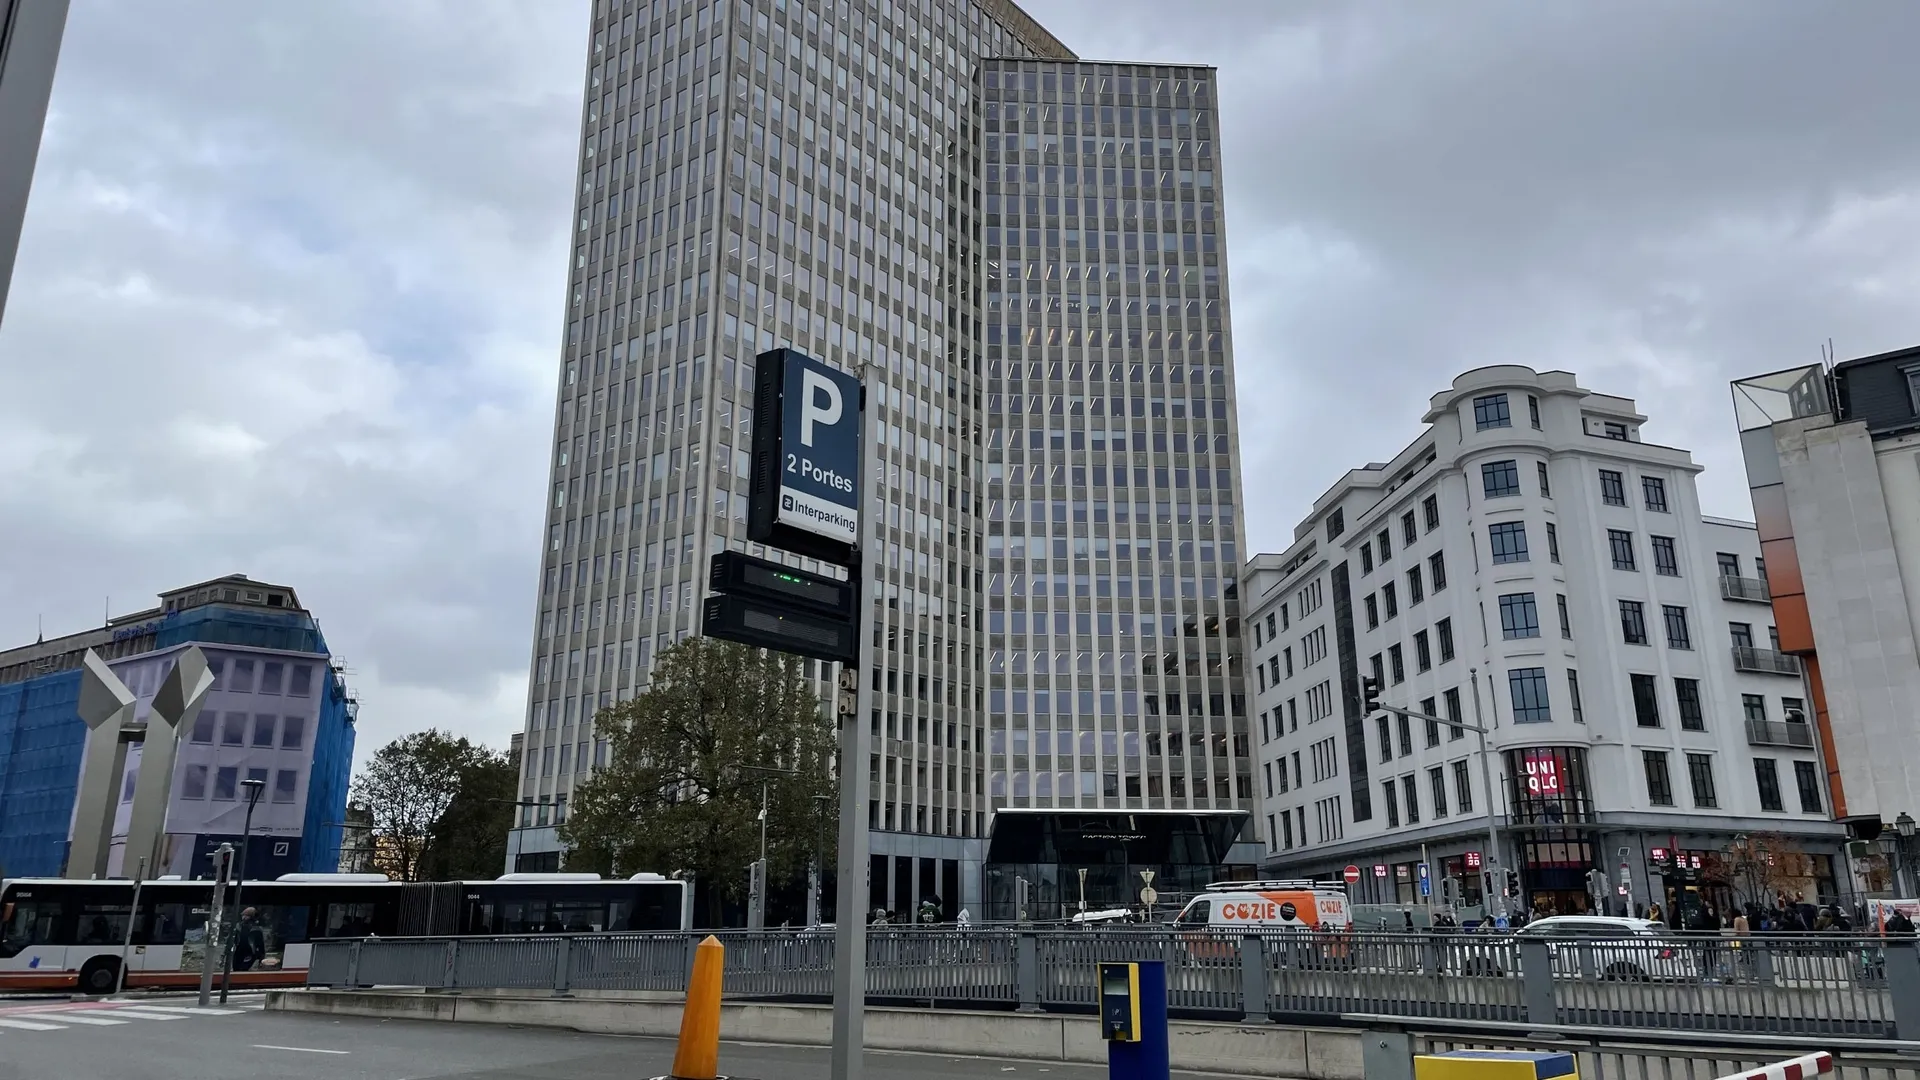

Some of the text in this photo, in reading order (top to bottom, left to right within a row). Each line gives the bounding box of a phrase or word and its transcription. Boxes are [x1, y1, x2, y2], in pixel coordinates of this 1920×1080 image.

[801, 368, 843, 447] P
[787, 453, 853, 493] 2 Portes
[795, 500, 855, 532] Interparking
[1526, 761, 1555, 774] UNI
[1529, 776, 1558, 792] QLO
[1222, 903, 1276, 920] COZIE
